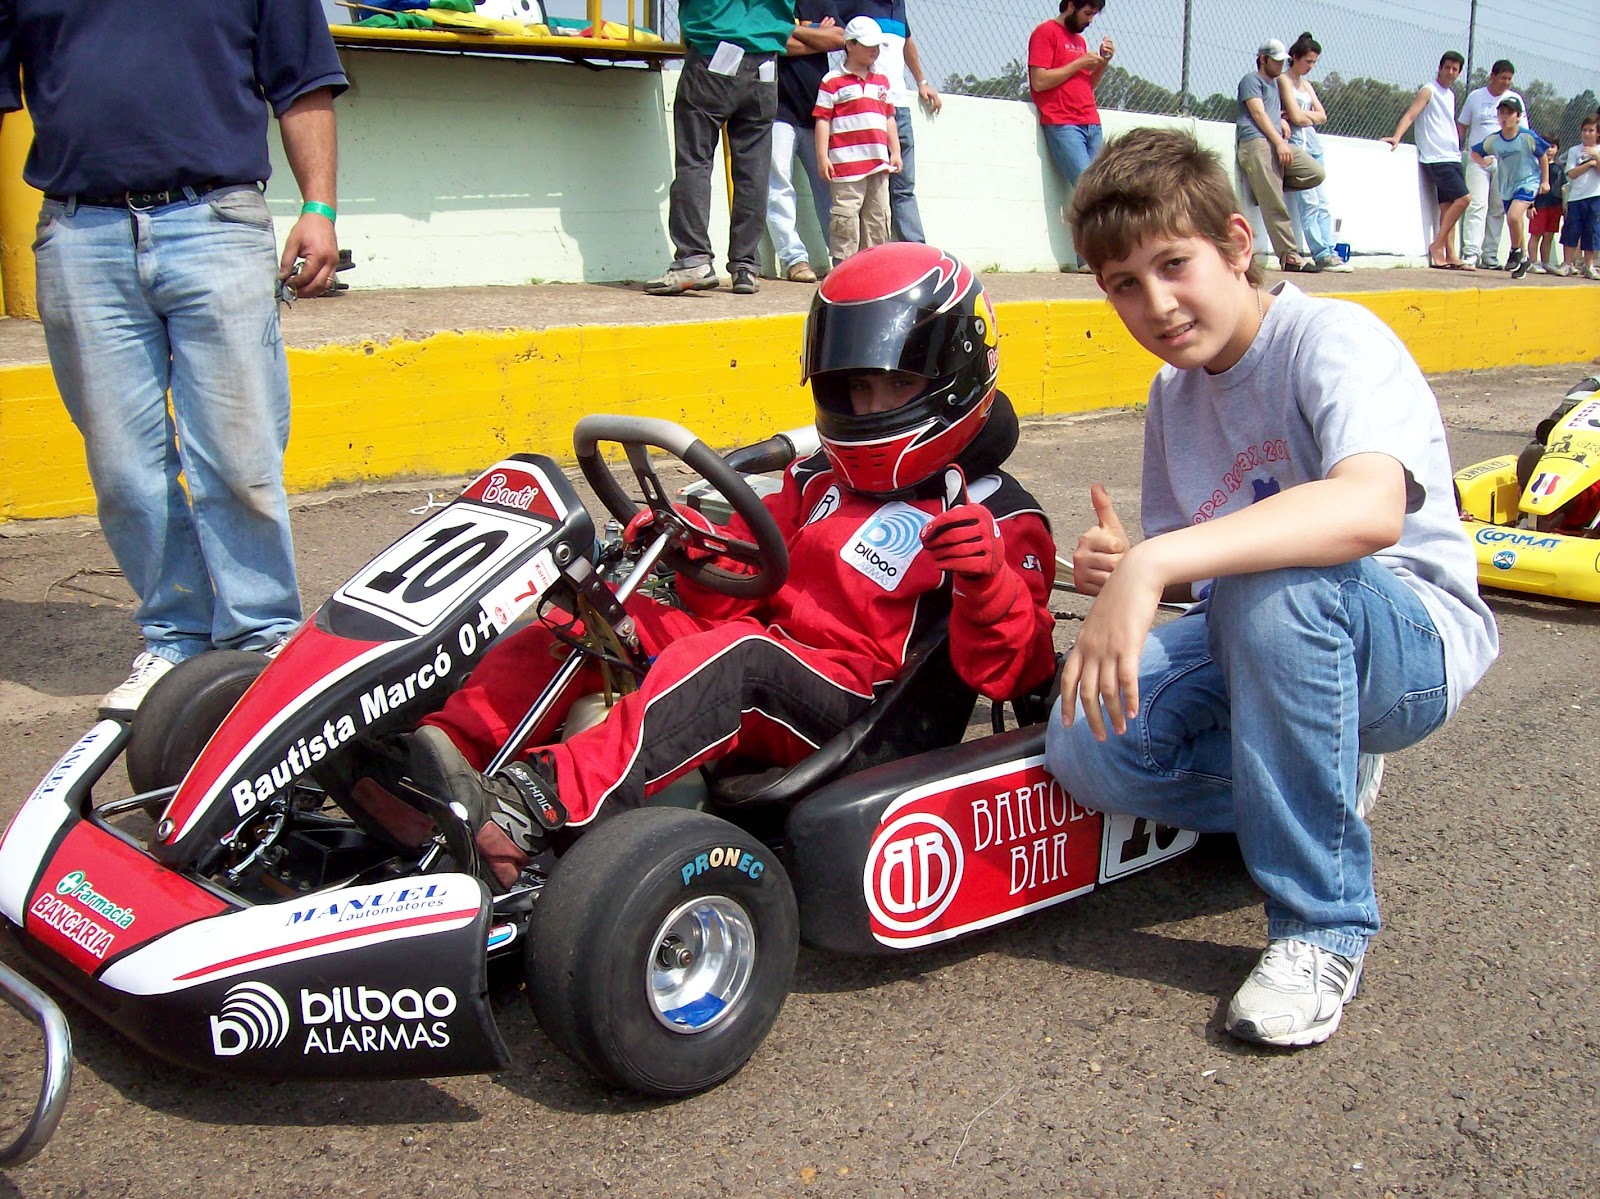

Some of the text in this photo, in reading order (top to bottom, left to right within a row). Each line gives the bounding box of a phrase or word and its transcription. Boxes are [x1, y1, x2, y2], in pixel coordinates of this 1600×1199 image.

[1263, 439, 1291, 462] 20
[481, 473, 539, 511] Bauti
[365, 521, 509, 604] 10
[854, 541, 897, 577] bilbao
[513, 579, 538, 603] 7
[229, 713, 357, 818] Bautista
[359, 644, 453, 726] Marcó
[971, 779, 1097, 852] BARTOL
[681, 847, 765, 887] PRONEC
[1009, 832, 1069, 896] BAR
[71, 880, 136, 930] Farmacia
[285, 884, 449, 927] MANUEL
[346, 898, 444, 921] automotores
[30, 892, 115, 959] BANCARIA
[300, 986, 457, 1025] bilbao
[303, 1021, 451, 1055] ALARMAS
